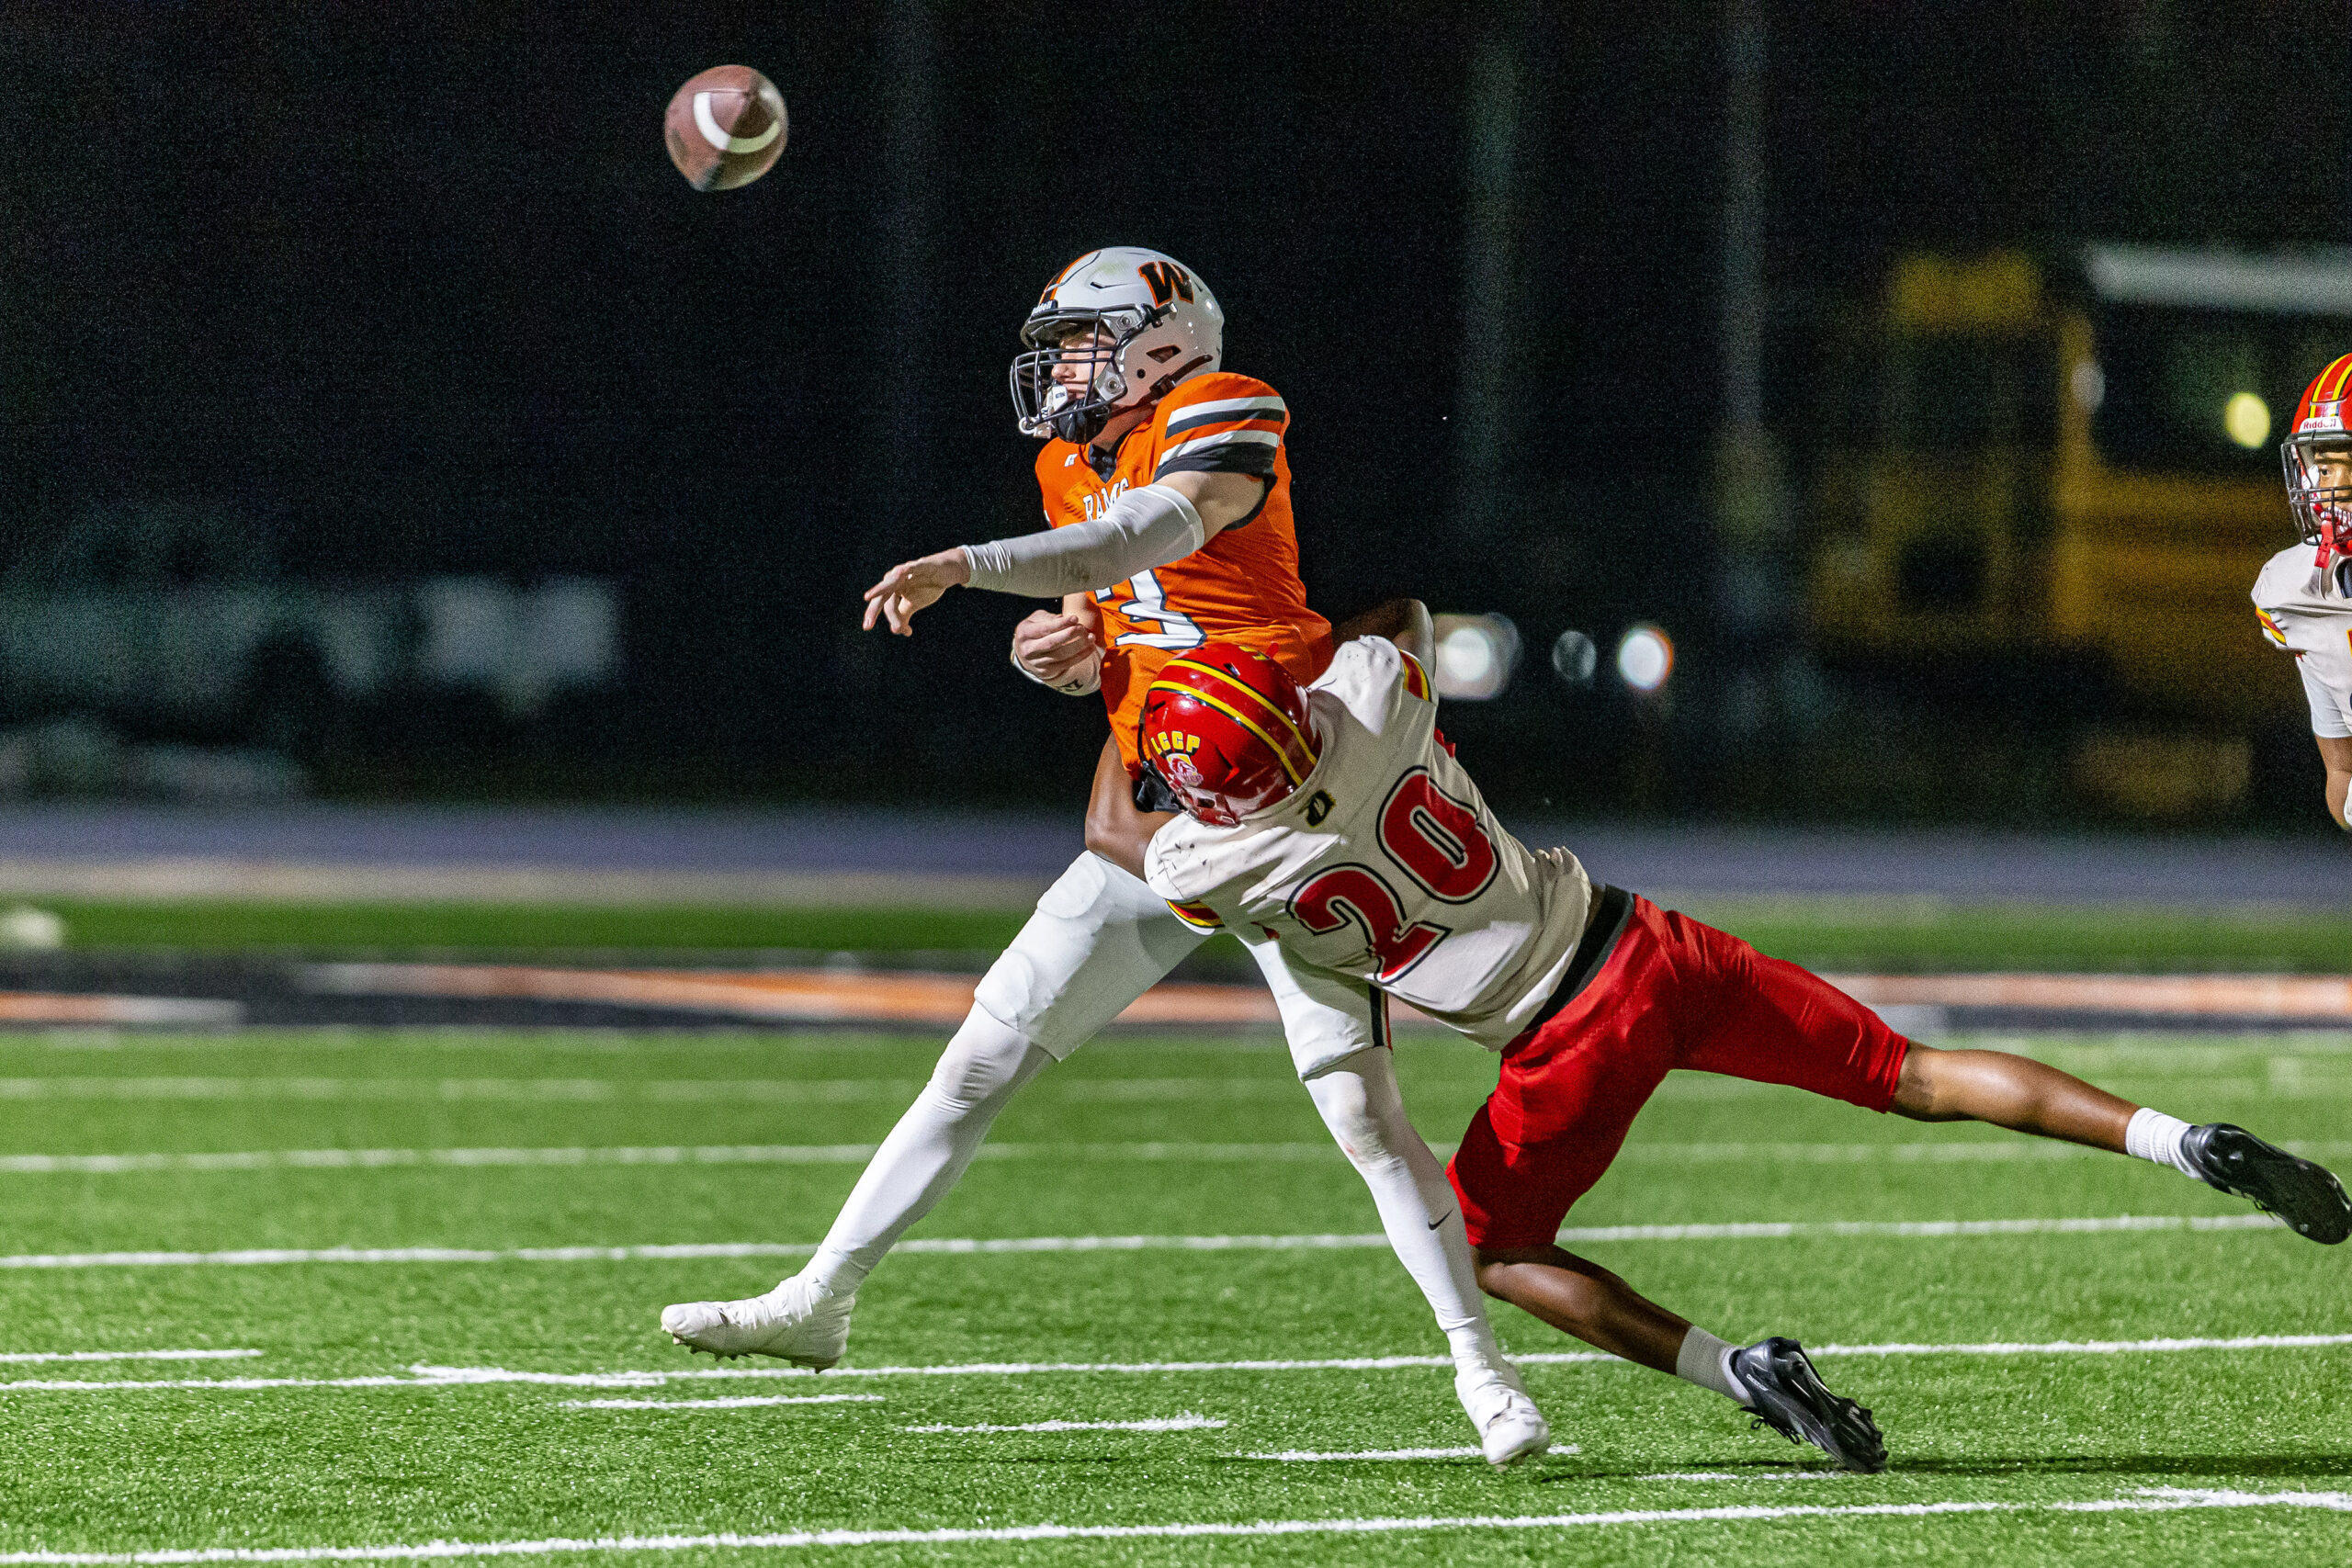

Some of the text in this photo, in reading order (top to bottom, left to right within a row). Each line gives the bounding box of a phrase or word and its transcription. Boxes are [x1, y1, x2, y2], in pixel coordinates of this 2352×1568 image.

[1137, 261, 1193, 309] W
[1150, 730, 1201, 755] LCCP
[1288, 766, 1500, 984] 20
